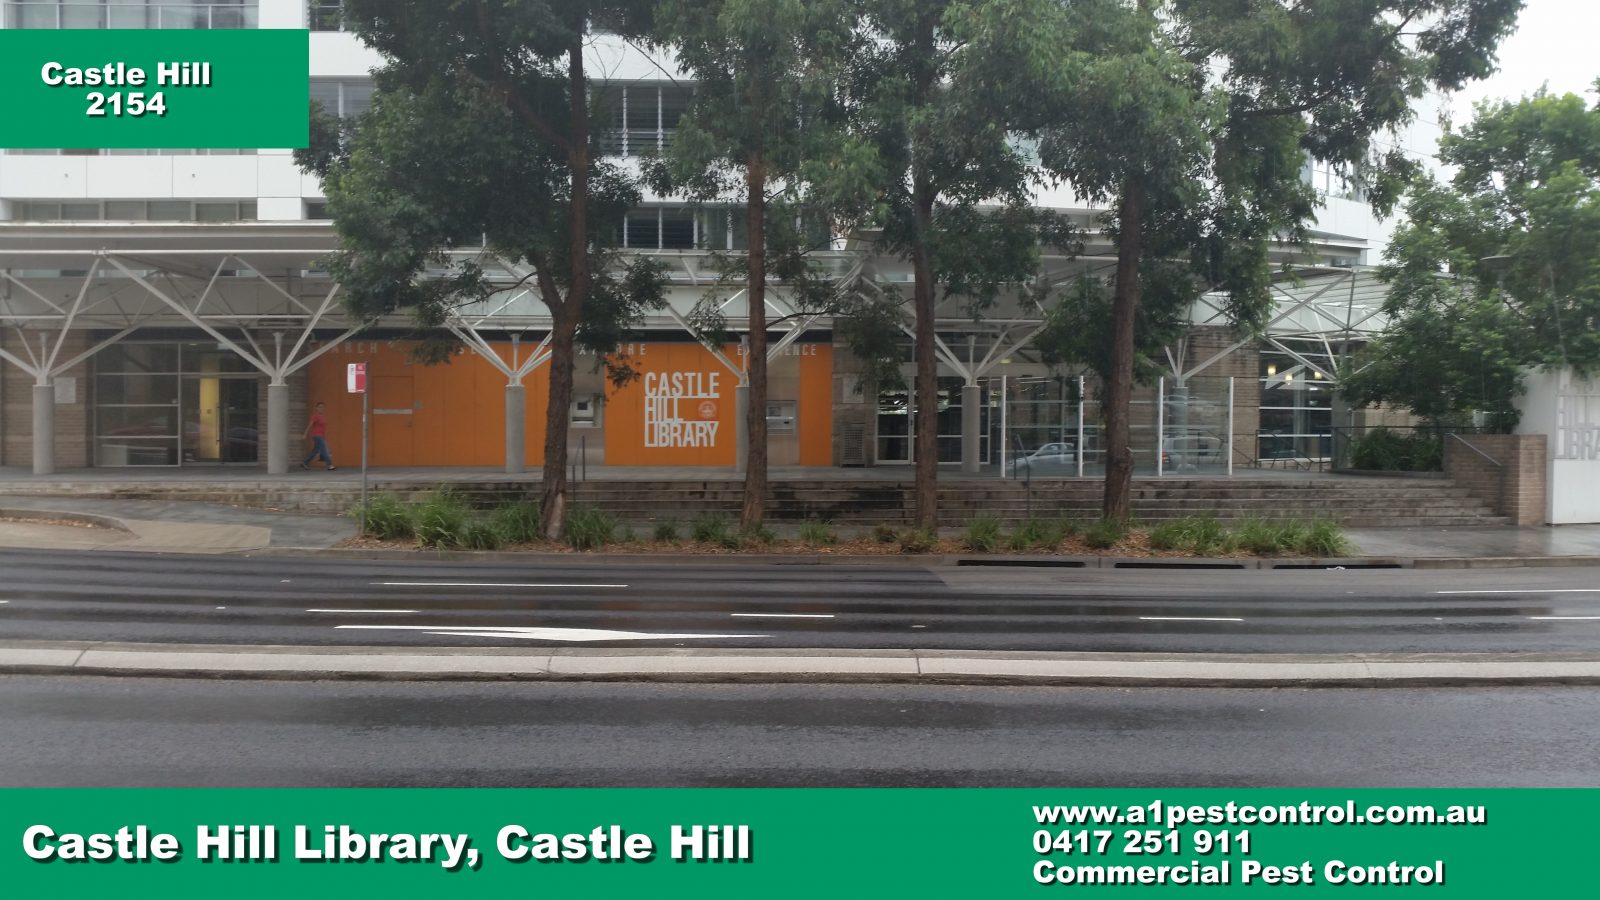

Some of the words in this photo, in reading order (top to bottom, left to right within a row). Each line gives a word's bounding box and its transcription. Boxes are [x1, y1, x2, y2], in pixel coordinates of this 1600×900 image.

[644, 372, 720, 398] CASTLE
[644, 397, 684, 423] HILL
[644, 422, 720, 448] LIBRARY
